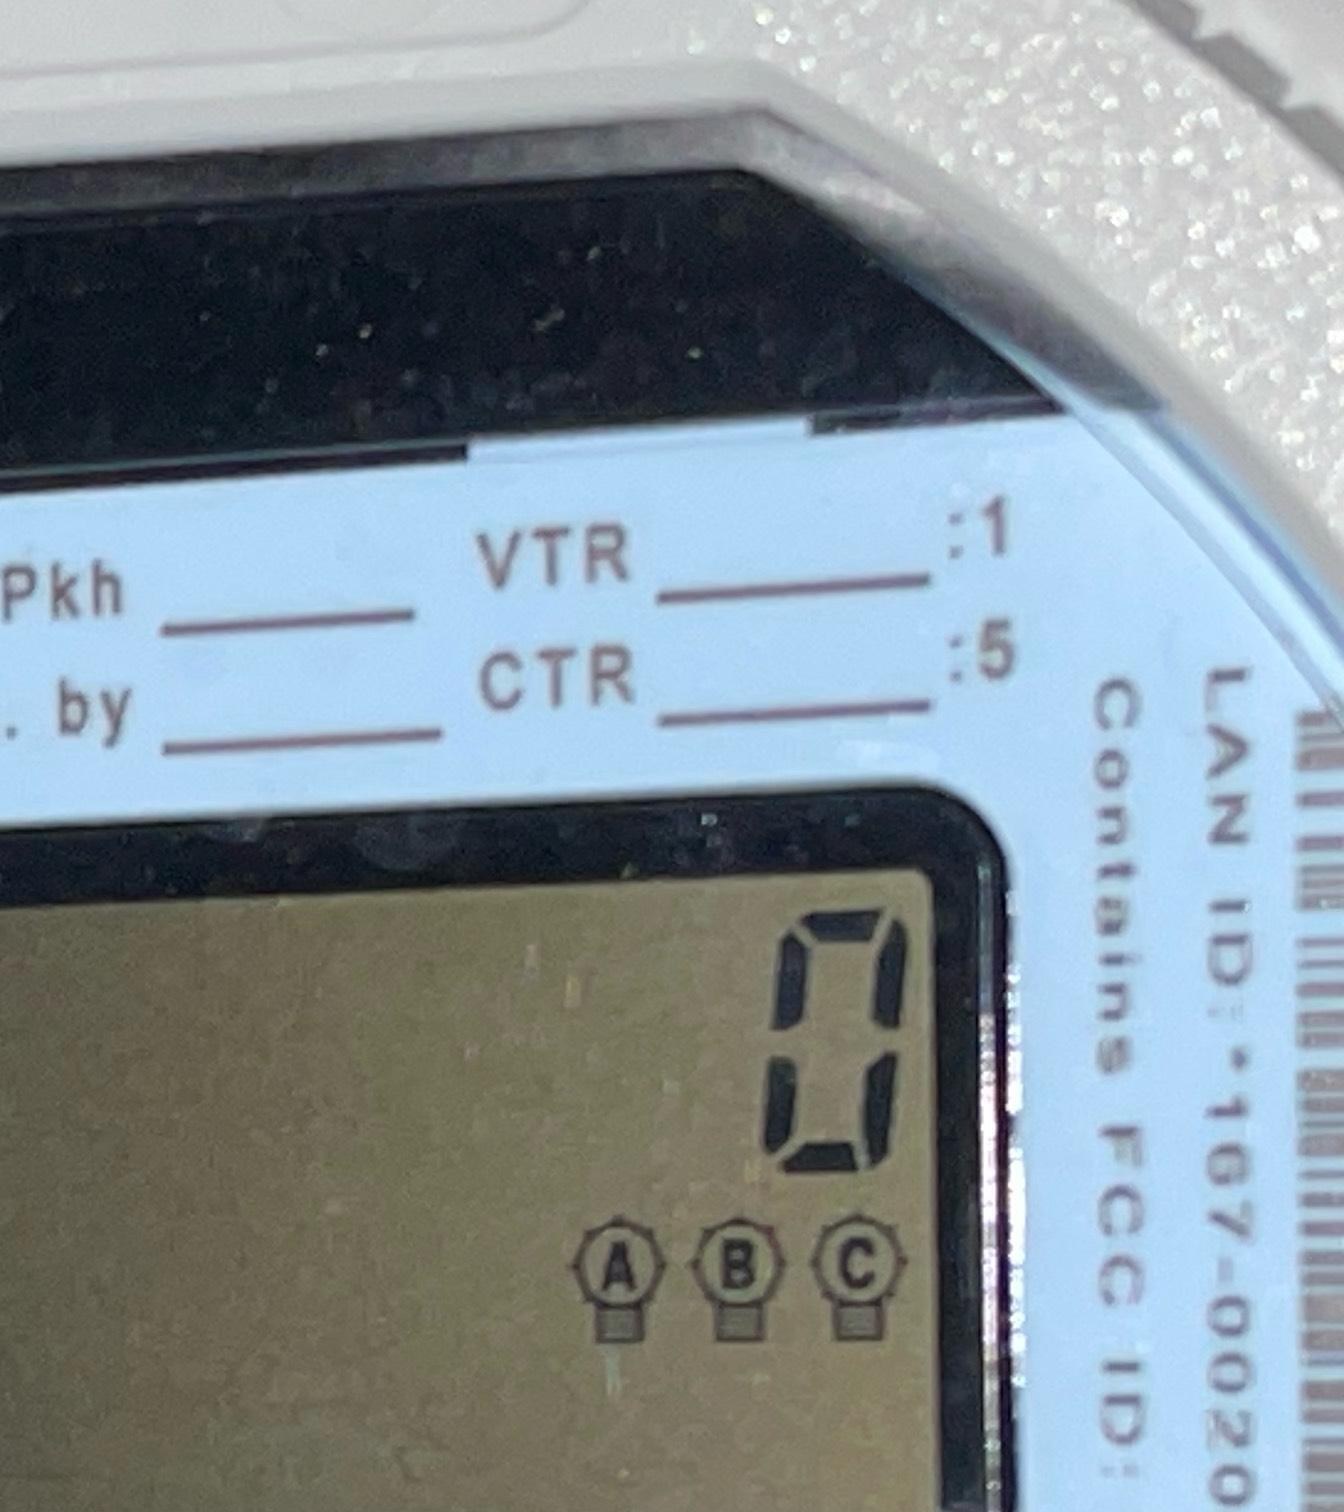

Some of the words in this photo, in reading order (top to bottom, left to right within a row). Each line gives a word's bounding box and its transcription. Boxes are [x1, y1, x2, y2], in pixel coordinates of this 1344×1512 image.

[474, 521, 633, 593] VTR
[946, 493, 1012, 562] :1
[478, 642, 638, 713] CTR
[947, 615, 1021, 686] :5
[56, 675, 134, 751] by
[1204, 665, 1253, 848] LAN
[1093, 675, 1143, 1077] Contains
[762, 908, 908, 1174] 0
[1097, 1122, 1147, 1309] FCC
[602, 1240, 637, 1292] A
[722, 1238, 756, 1290] B
[839, 1237, 876, 1289] C
